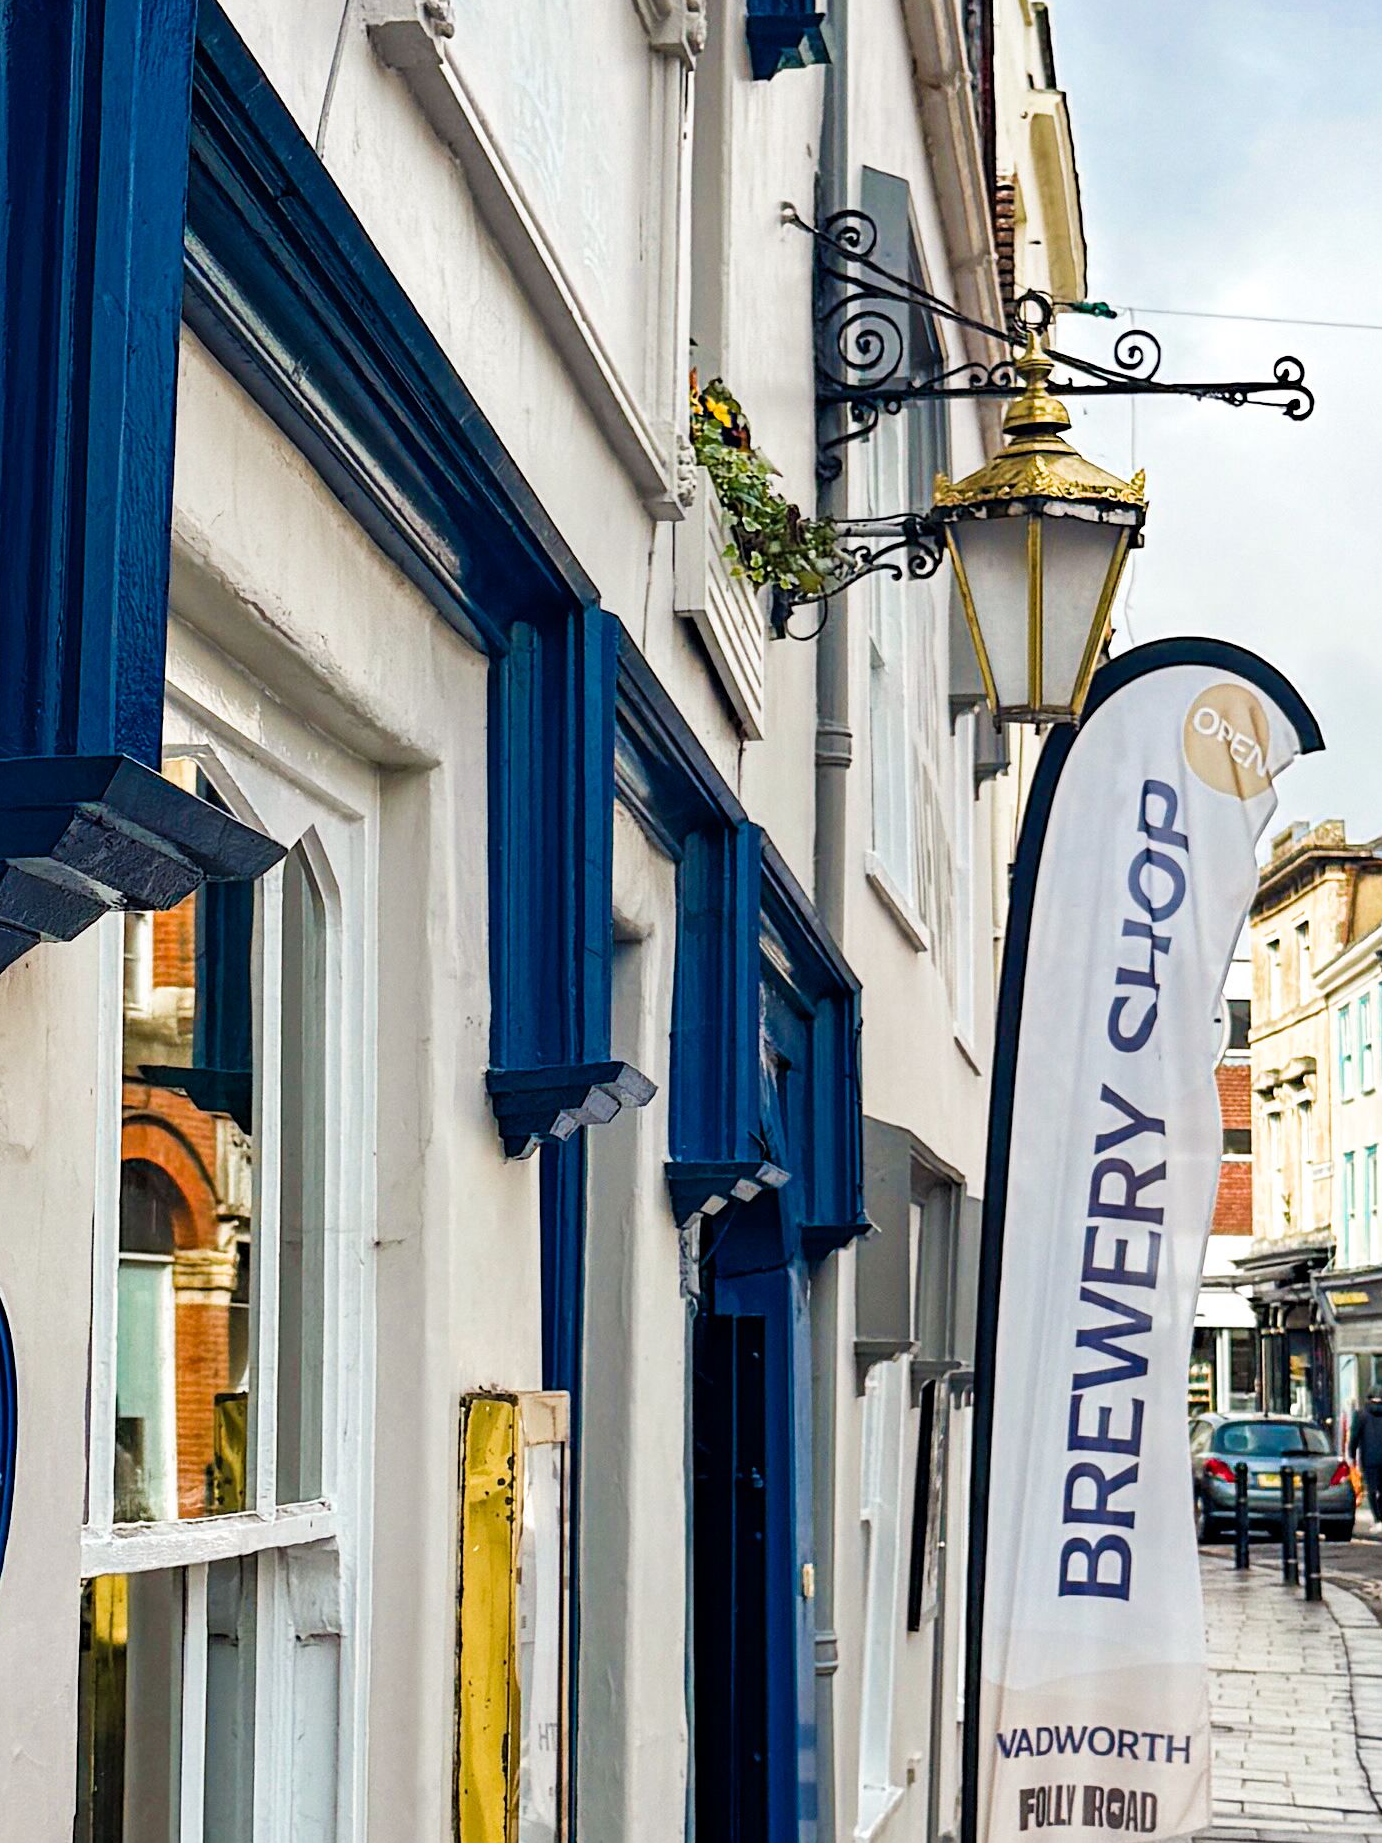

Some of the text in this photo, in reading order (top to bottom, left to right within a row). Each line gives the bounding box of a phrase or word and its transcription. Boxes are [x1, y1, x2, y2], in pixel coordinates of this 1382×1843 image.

[1193, 707, 1267, 778] OPEN
[1059, 778, 1192, 1604] BREWERY SHOP
[1019, 1784, 1158, 1833] FOLLY ROAD
